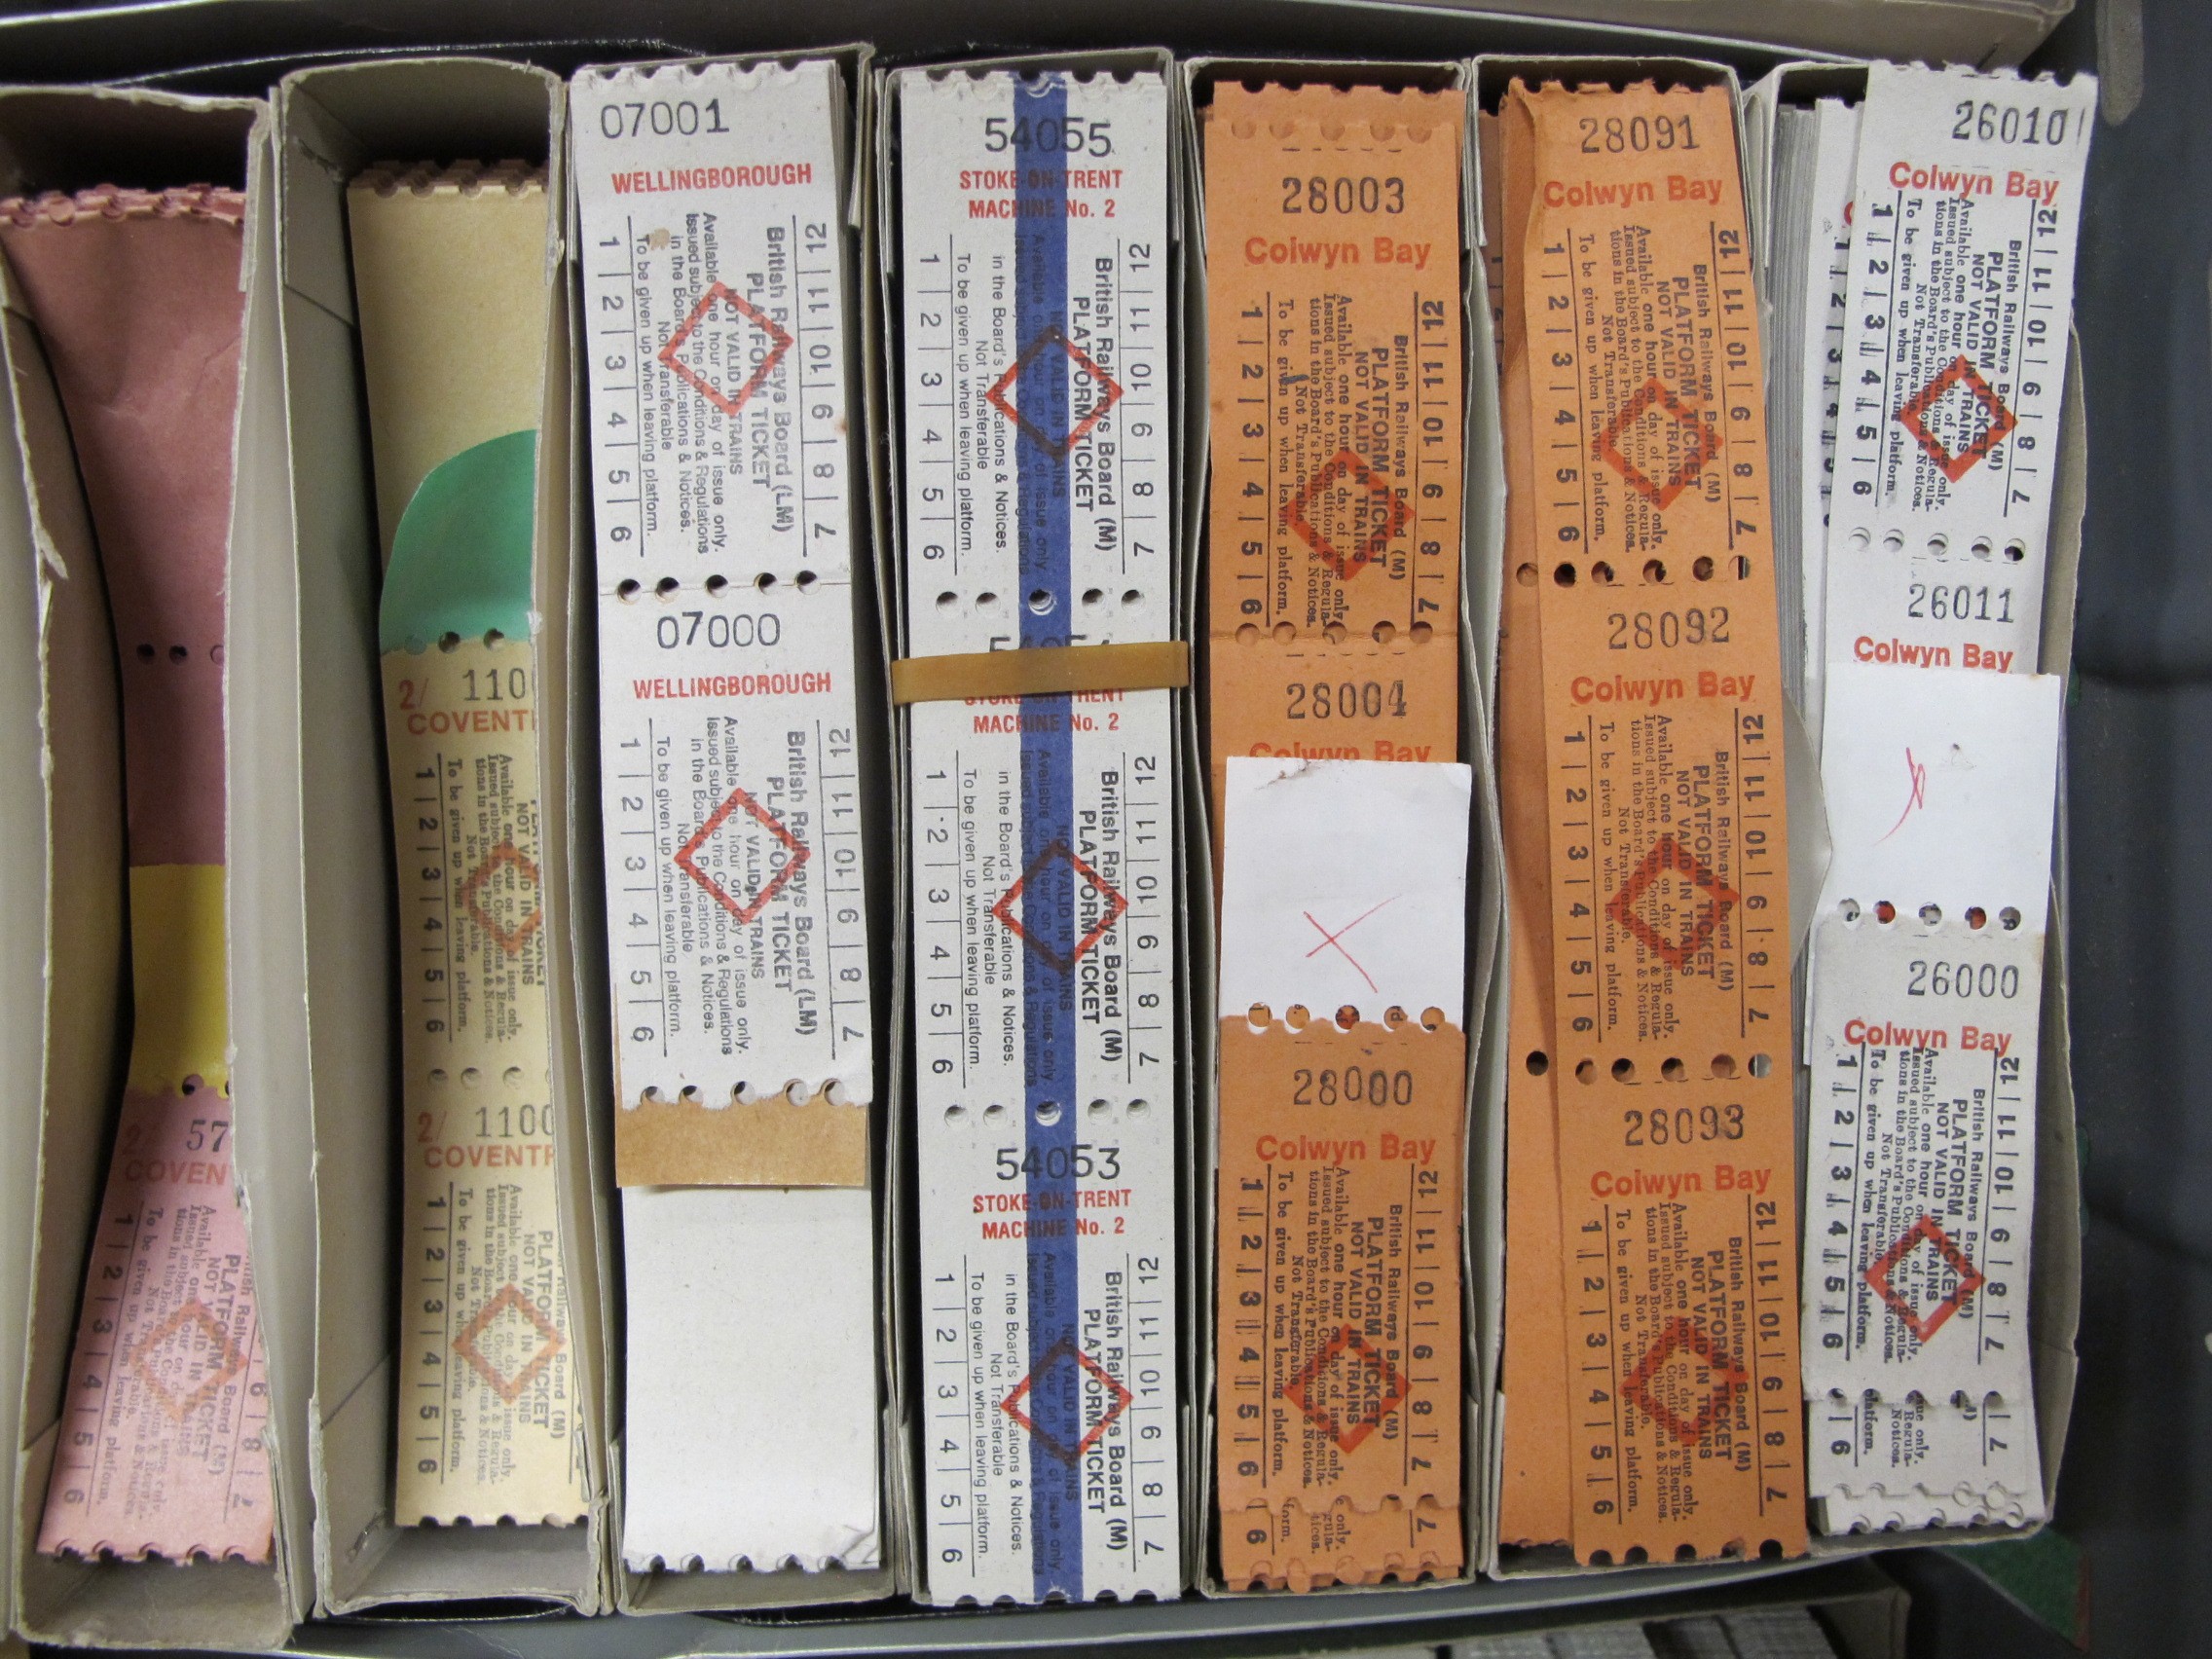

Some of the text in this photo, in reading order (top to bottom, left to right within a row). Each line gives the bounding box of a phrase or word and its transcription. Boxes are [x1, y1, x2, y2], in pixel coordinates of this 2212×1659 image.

[601, 98, 729, 138] 07001
[1952, 99, 2069, 146] 26010
[984, 116, 1112, 157] 54055
[1579, 114, 1700, 154] 28091
[611, 163, 812, 194] WELLINGBOROUGH
[1543, 175, 1723, 207] Colwyn Bay
[1889, 162, 2059, 206] Colwyn Bay
[1282, 177, 1405, 214] 28003
[969, 200, 1116, 219] MACHINE No. 2
[1871, 203, 1894, 216] 1
[2038, 209, 2057, 238] 12
[1244, 237, 1432, 271] Colwyn Bay
[2004, 240, 2022, 292] British
[1868, 260, 1889, 275] 2
[2032, 268, 2051, 291] 11
[1693, 264, 1708, 317] British
[1864, 314, 1885, 329] 3
[1980, 252, 2003, 369] PLATFORM
[2027, 322, 2045, 348] 10
[1885, 199, 1922, 497] To be given up when leaving platform.
[637, 238, 658, 535] To be given up when leaving platform.
[747, 274, 772, 488] PLATFORM TICKET
[767, 228, 794, 532] British Railways Board (LM)
[1579, 234, 1608, 541] To be given up when leaving platform.
[1673, 276, 1701, 489] PLATFORM TICKET
[1862, 370, 1882, 386] 4
[2022, 382, 2041, 396] 9
[955, 253, 974, 557] To be given up when leaving platform.
[976, 341, 988, 469] Not Transferable
[1073, 297, 1094, 511] PLATFORM TICKET
[1094, 258, 1117, 551] British Railways Board (M)
[1857, 425, 1877, 440] 5
[1958, 389, 1974, 453] TRAINS
[728, 412, 743, 475] TRAINS
[2017, 437, 2036, 451] 8
[1853, 481, 1872, 496] 6
[2011, 490, 2030, 503] 7
[995, 491, 1007, 553] Notices.
[1908, 583, 2013, 623] 26011
[657, 611, 780, 648] 07000
[1608, 606, 1729, 649] 28092
[1854, 636, 2013, 673] Colwyn Bay
[462, 668, 536, 701] 110
[633, 672, 831, 699] WELLINGBOROUGH
[1570, 671, 1755, 706] Colwyn Bay
[1286, 680, 1407, 719] 28004
[407, 710, 536, 734] COVENT
[974, 713, 1120, 733] MACHINE No. 2
[620, 739, 641, 748] 1
[829, 728, 851, 757] 12
[622, 797, 644, 812] 2
[832, 793, 854, 818] 11
[625, 857, 646, 871] 3
[834, 849, 856, 876] 10
[628, 913, 648, 928] 4
[838, 908, 860, 924] 9
[631, 971, 651, 984] 5
[839, 968, 863, 982] 8
[1907, 960, 2019, 998] 26000
[633, 1027, 654, 1042] 6
[842, 1027, 865, 1042] 7
[1844, 1019, 2011, 1057] Colwyn Bay
[1293, 1066, 1413, 1106] 28000
[1624, 1104, 1744, 1146] 28093
[1256, 1132, 1436, 1165] Colwyn Bay
[996, 1143, 1121, 1180] 54053
[1240, 1179, 1264, 1191] 1
[1590, 1164, 1771, 1199] Colwyn Bay
[427, 1197, 446, 1207] 1
[982, 1217, 1124, 1239] MACHINE No. 2
[425, 1248, 445, 1261] 2
[1240, 1235, 1262, 1249] 2
[935, 1273, 955, 1283] 1
[1138, 1258, 1159, 1283] 12
[424, 1300, 443, 1313] 3
[1239, 1292, 1261, 1306] 3
[937, 1328, 957, 1342] 2
[1140, 1318, 1159, 1339] 11
[423, 1352, 441, 1366] 4
[1239, 1347, 1260, 1361] 4
[939, 1385, 959, 1398] 3
[1139, 1370, 1161, 1395] 10
[421, 1406, 439, 1419] 5
[1237, 1404, 1259, 1419] 5
[1141, 1426, 1161, 1440] 9
[940, 1440, 960, 1453] 4
[419, 1460, 436, 1473] 6
[1237, 1461, 1259, 1476] 6
[941, 1494, 962, 1507] 5
[1143, 1483, 1163, 1496] 8
[941, 1549, 963, 1563] 6
[1144, 1542, 1164, 1554] 7
